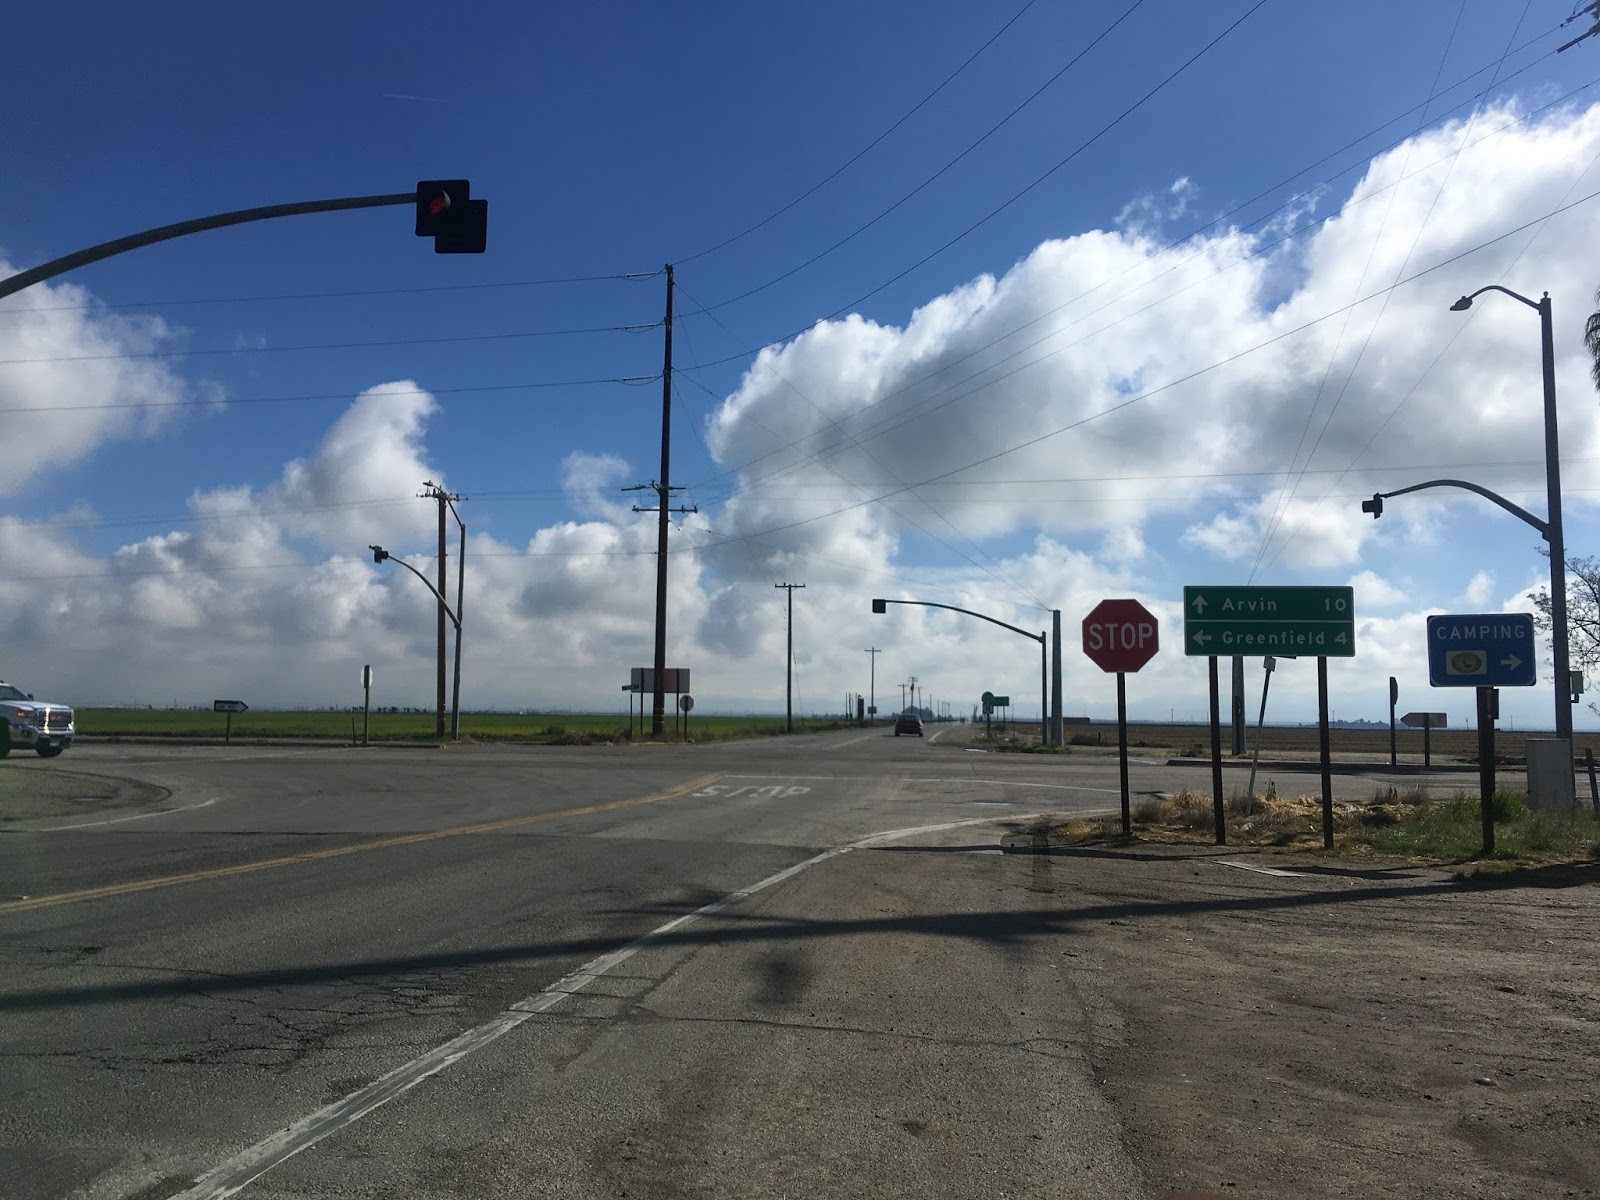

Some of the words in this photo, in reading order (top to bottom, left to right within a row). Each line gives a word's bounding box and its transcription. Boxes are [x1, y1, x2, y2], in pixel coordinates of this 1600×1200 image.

[1222, 597, 1277, 612] Arvin
[1325, 598, 1347, 612] 10
[1088, 622, 1153, 650] STOP
[1222, 630, 1325, 645] Greenfield
[1334, 631, 1347, 645] 4
[1436, 625, 1525, 640] CAMPING
